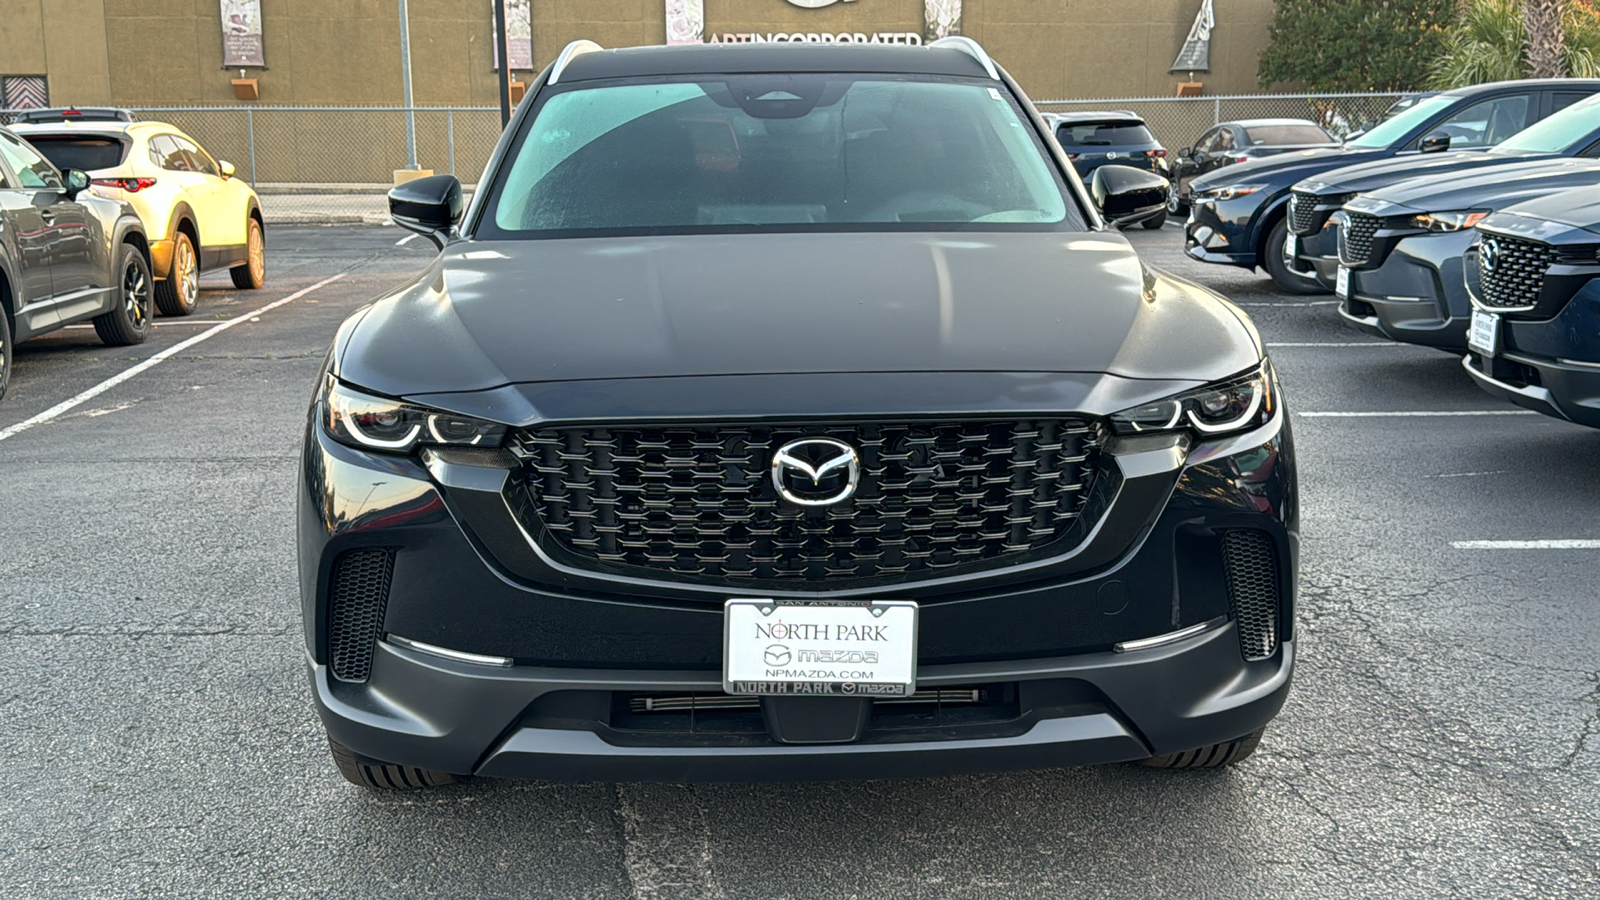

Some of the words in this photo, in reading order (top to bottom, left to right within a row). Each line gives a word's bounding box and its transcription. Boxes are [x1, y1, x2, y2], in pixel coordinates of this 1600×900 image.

[754, 622, 830, 641] NORTH
[836, 624, 889, 642] PARK
[797, 649, 879, 664] mazda
[765, 669, 874, 679] NPMAZDA.COM
[737, 682, 787, 693] NORTH
[793, 682, 833, 693] PARK
[858, 684, 904, 694] mazda
